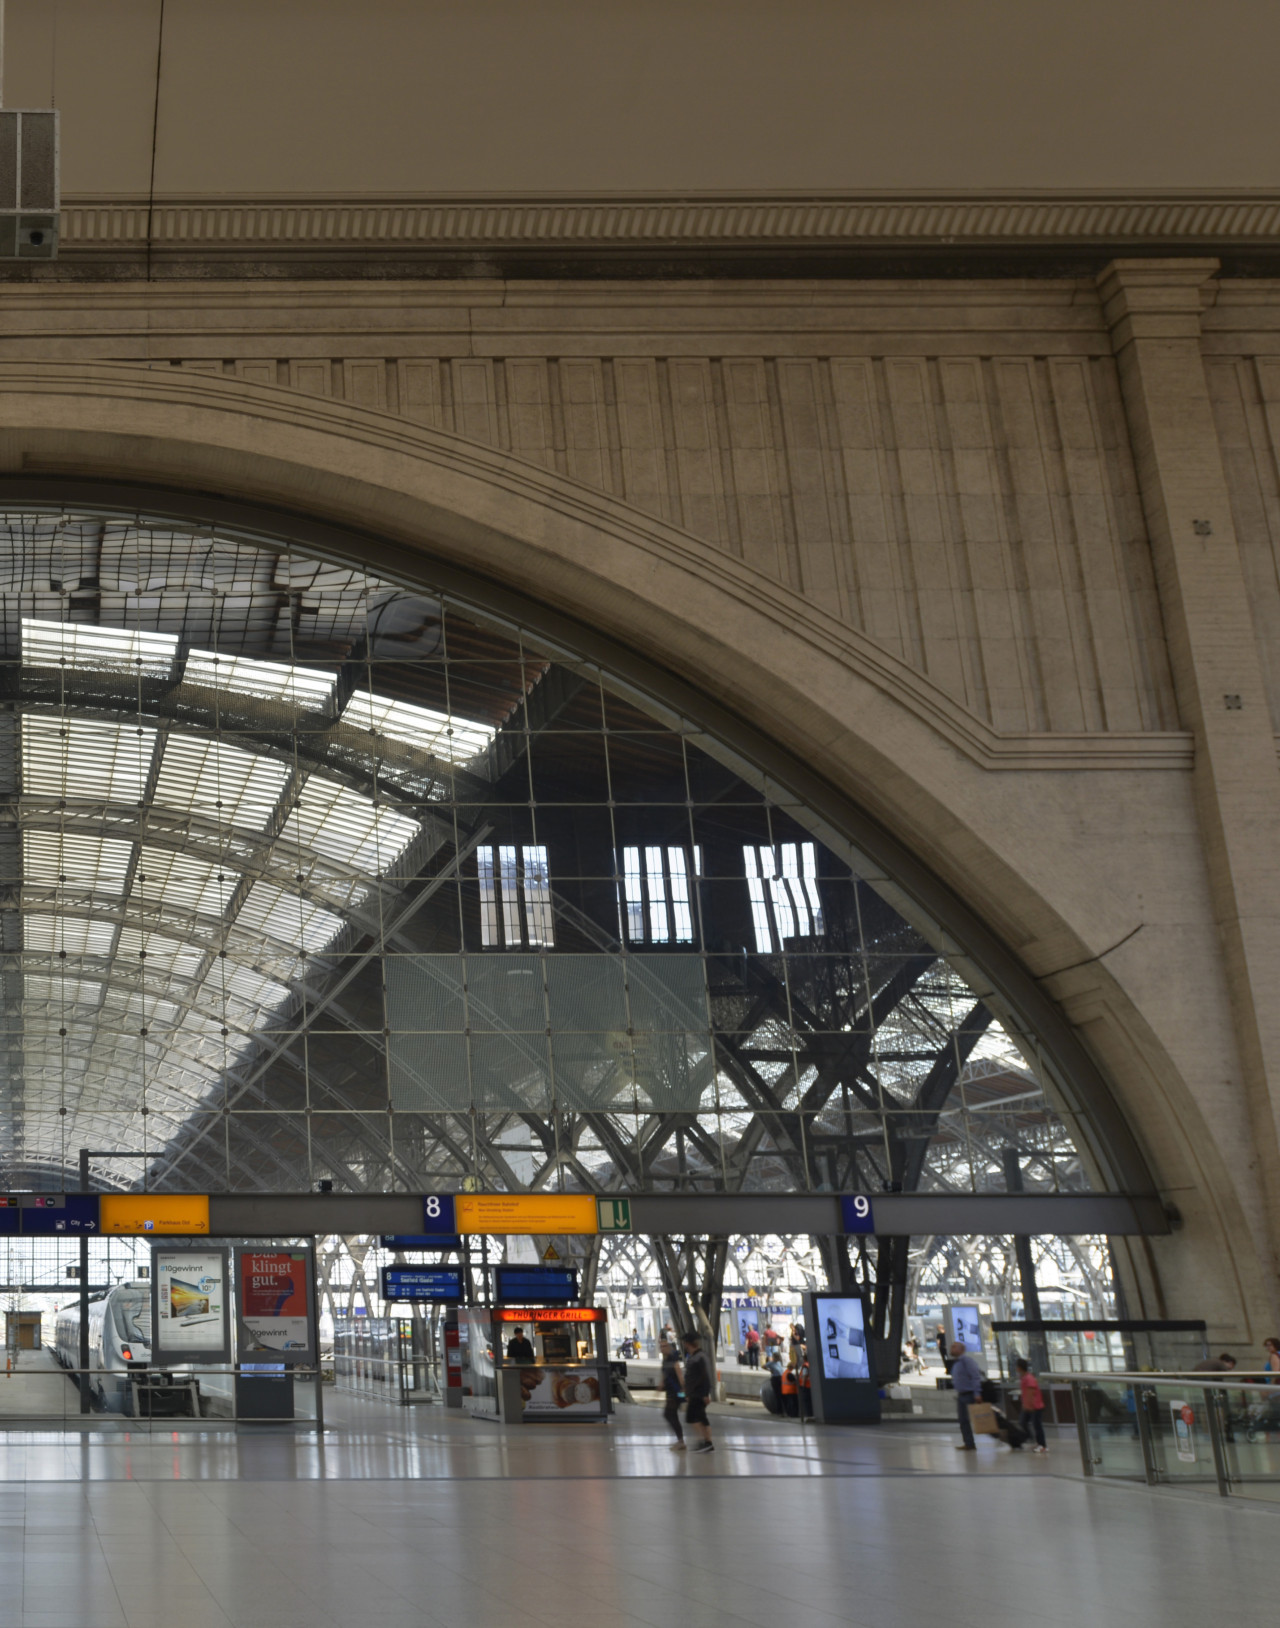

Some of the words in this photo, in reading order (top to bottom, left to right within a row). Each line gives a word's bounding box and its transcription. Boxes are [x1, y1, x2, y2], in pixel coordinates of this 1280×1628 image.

[426, 1195, 441, 1218] 8
[854, 1196, 869, 1218] 9
[70, 1219, 81, 1227] City
[160, 1264, 204, 1273] #10gewinnt
[252, 1260, 292, 1275] klingt
[386, 1272, 392, 1281] 8
[566, 1274, 572, 1282] 9
[252, 1274, 278, 1289] gut.
[560, 1311, 582, 1319] GRILL
